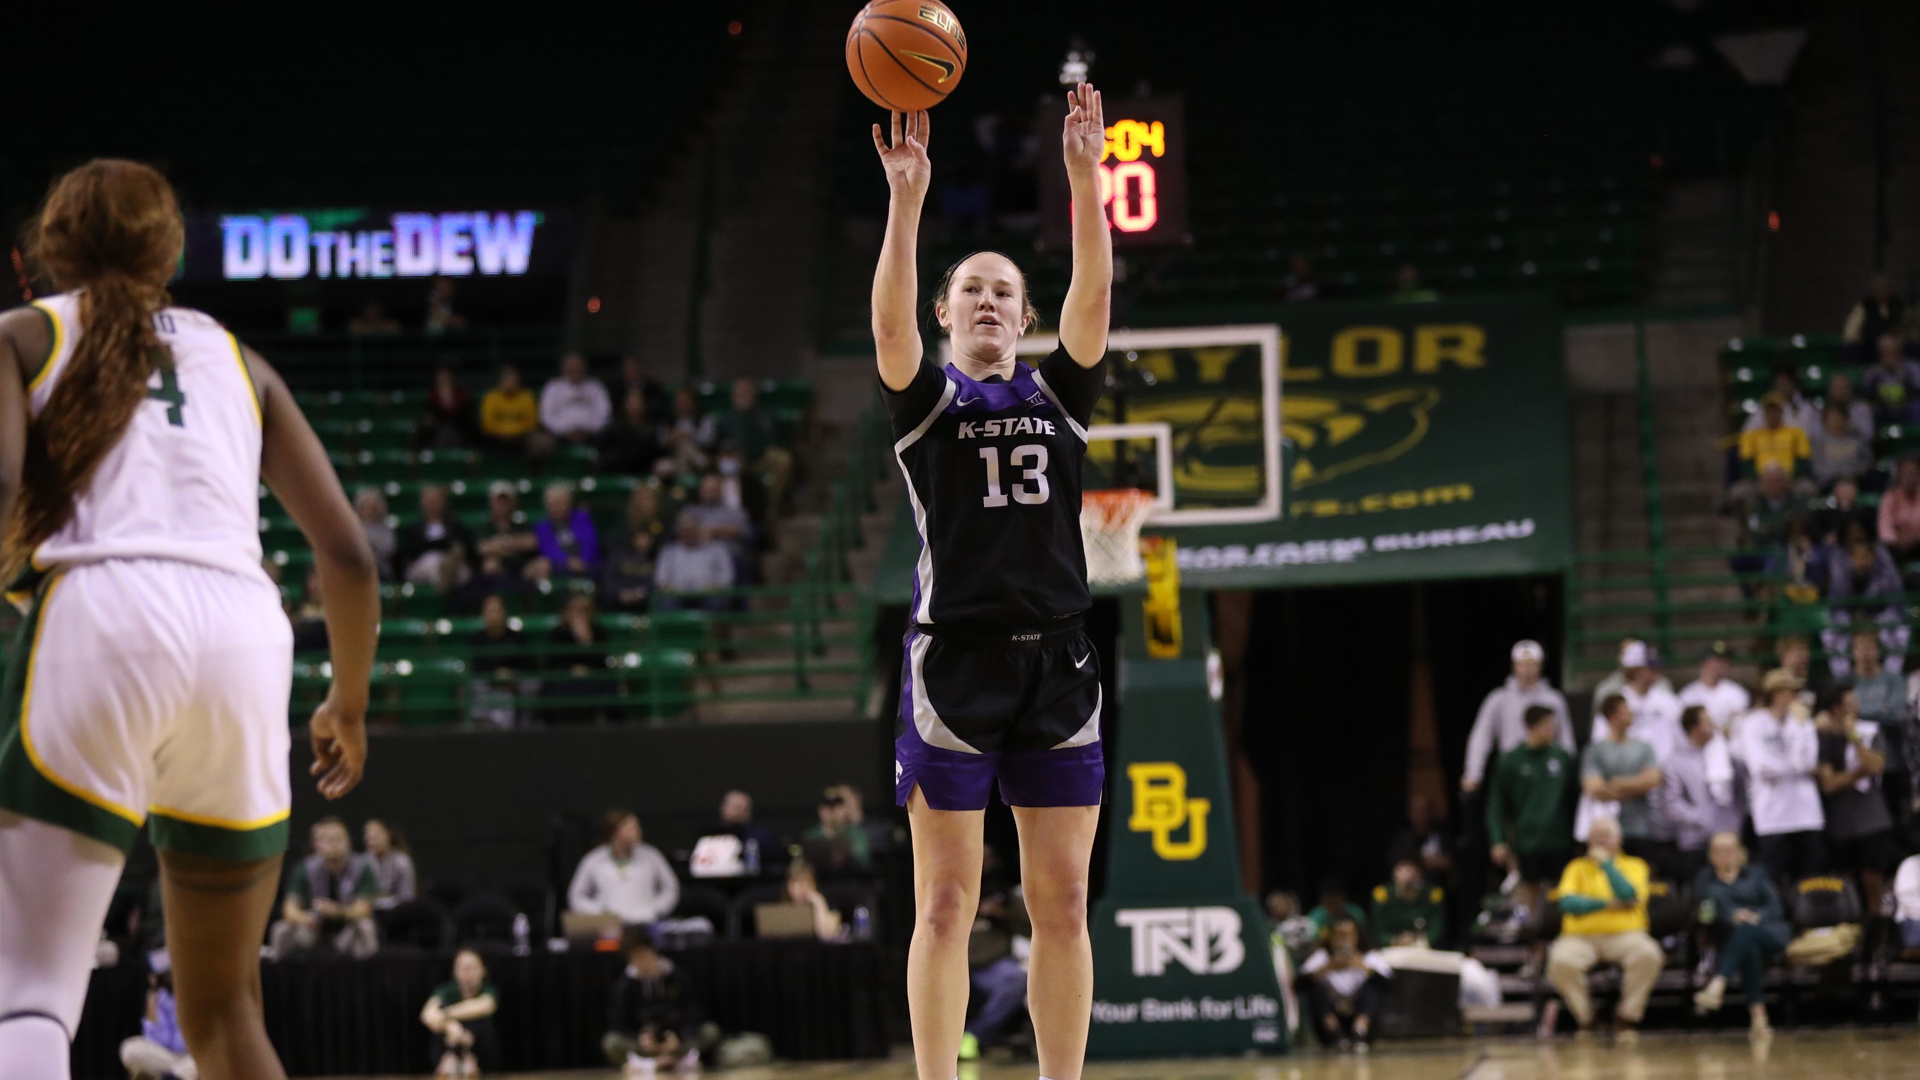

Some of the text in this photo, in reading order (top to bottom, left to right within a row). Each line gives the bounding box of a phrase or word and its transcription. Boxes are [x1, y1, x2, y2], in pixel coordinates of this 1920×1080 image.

[918, 5, 966, 51] ELITE
[1101, 119, 1165, 162] :04
[220, 210, 535, 280] DO THE DEW
[957, 416, 1056, 439] K-STATE
[979, 444, 1050, 508] 13
[1372, 518, 1536, 552] BUREAU
[1011, 633, 1042, 642] K-STATE
[1126, 761, 1211, 861] BU
[1091, 995, 1279, 1023] Your Bank for Life
